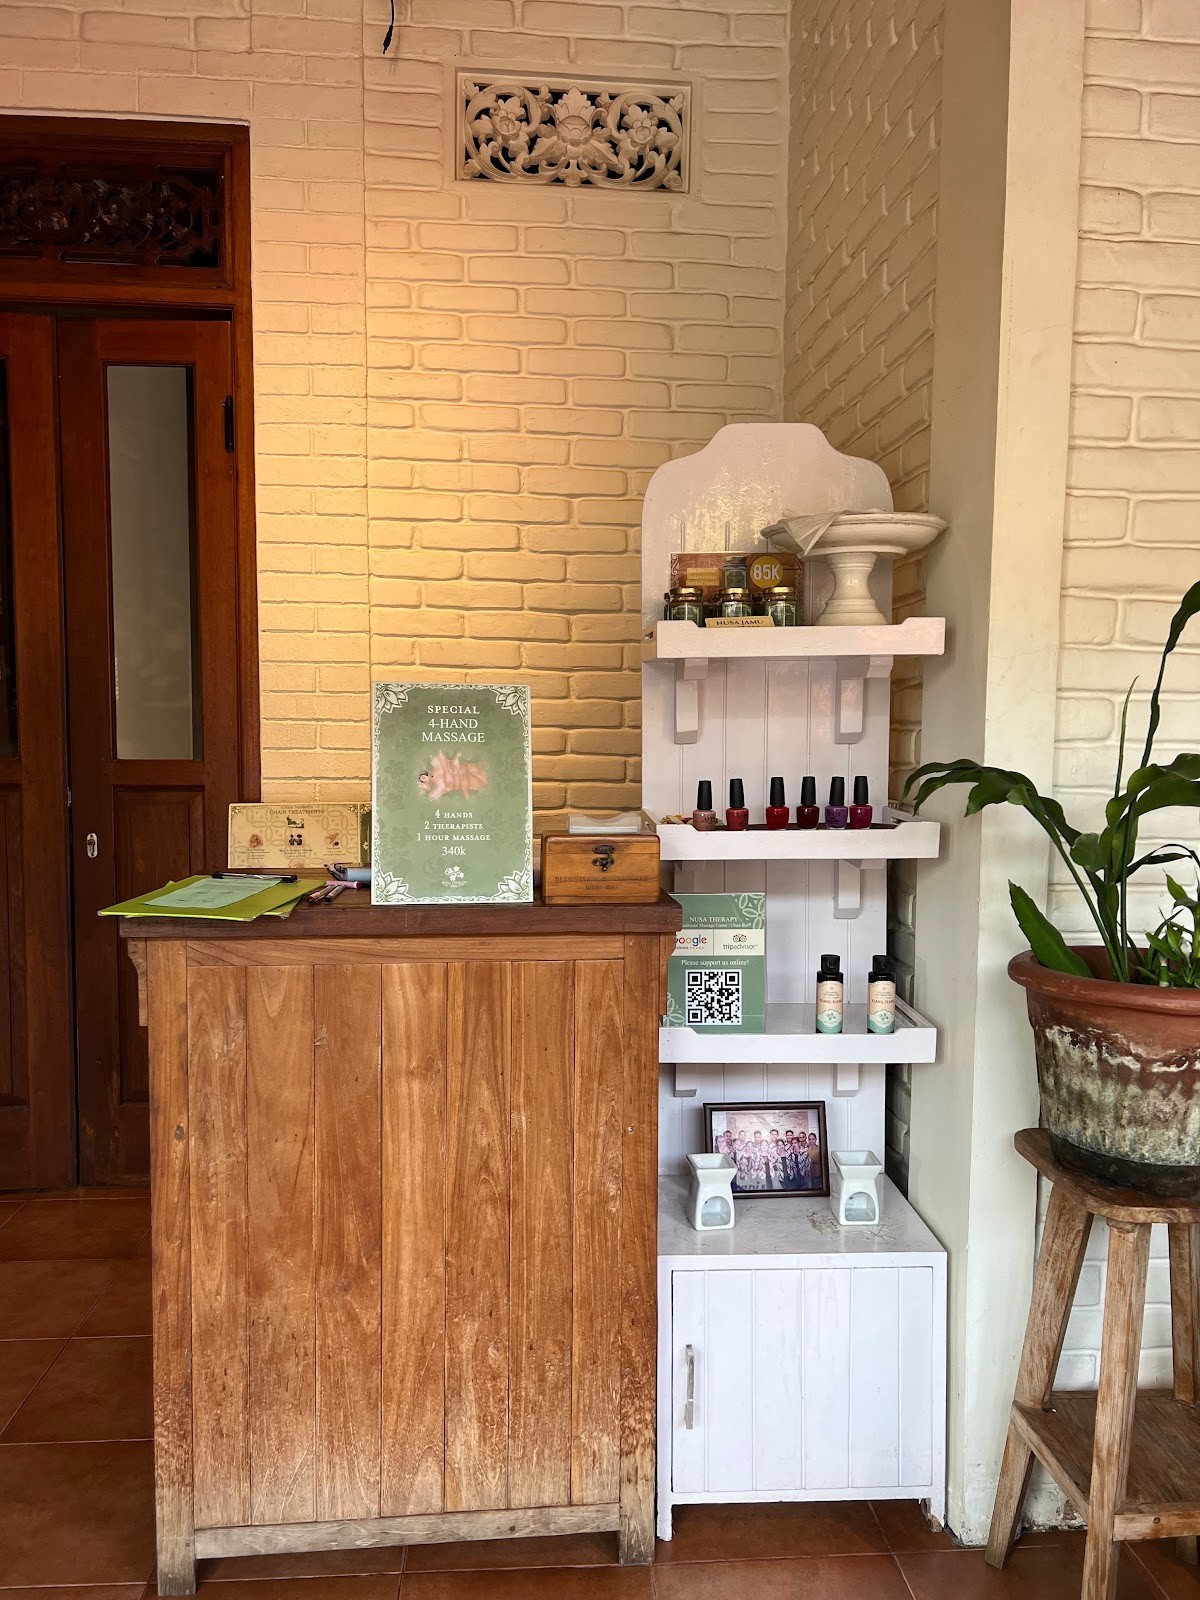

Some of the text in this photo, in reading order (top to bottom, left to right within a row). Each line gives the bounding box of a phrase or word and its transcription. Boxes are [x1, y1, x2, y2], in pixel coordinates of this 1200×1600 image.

[752, 563, 781, 582] 85K
[427, 704, 481, 715] SPECIAL
[428, 718, 479, 729] 4-HAND
[421, 731, 486, 743] MASSAGE
[434, 808, 473, 819] 4 HANDS
[424, 820, 430, 830] 2
[417, 832, 421, 841] 1
[441, 845, 467, 856] 340k
[676, 934, 707, 947] oogle
[722, 943, 757, 951] tripadvisor
[700, 959, 721, 967] support
